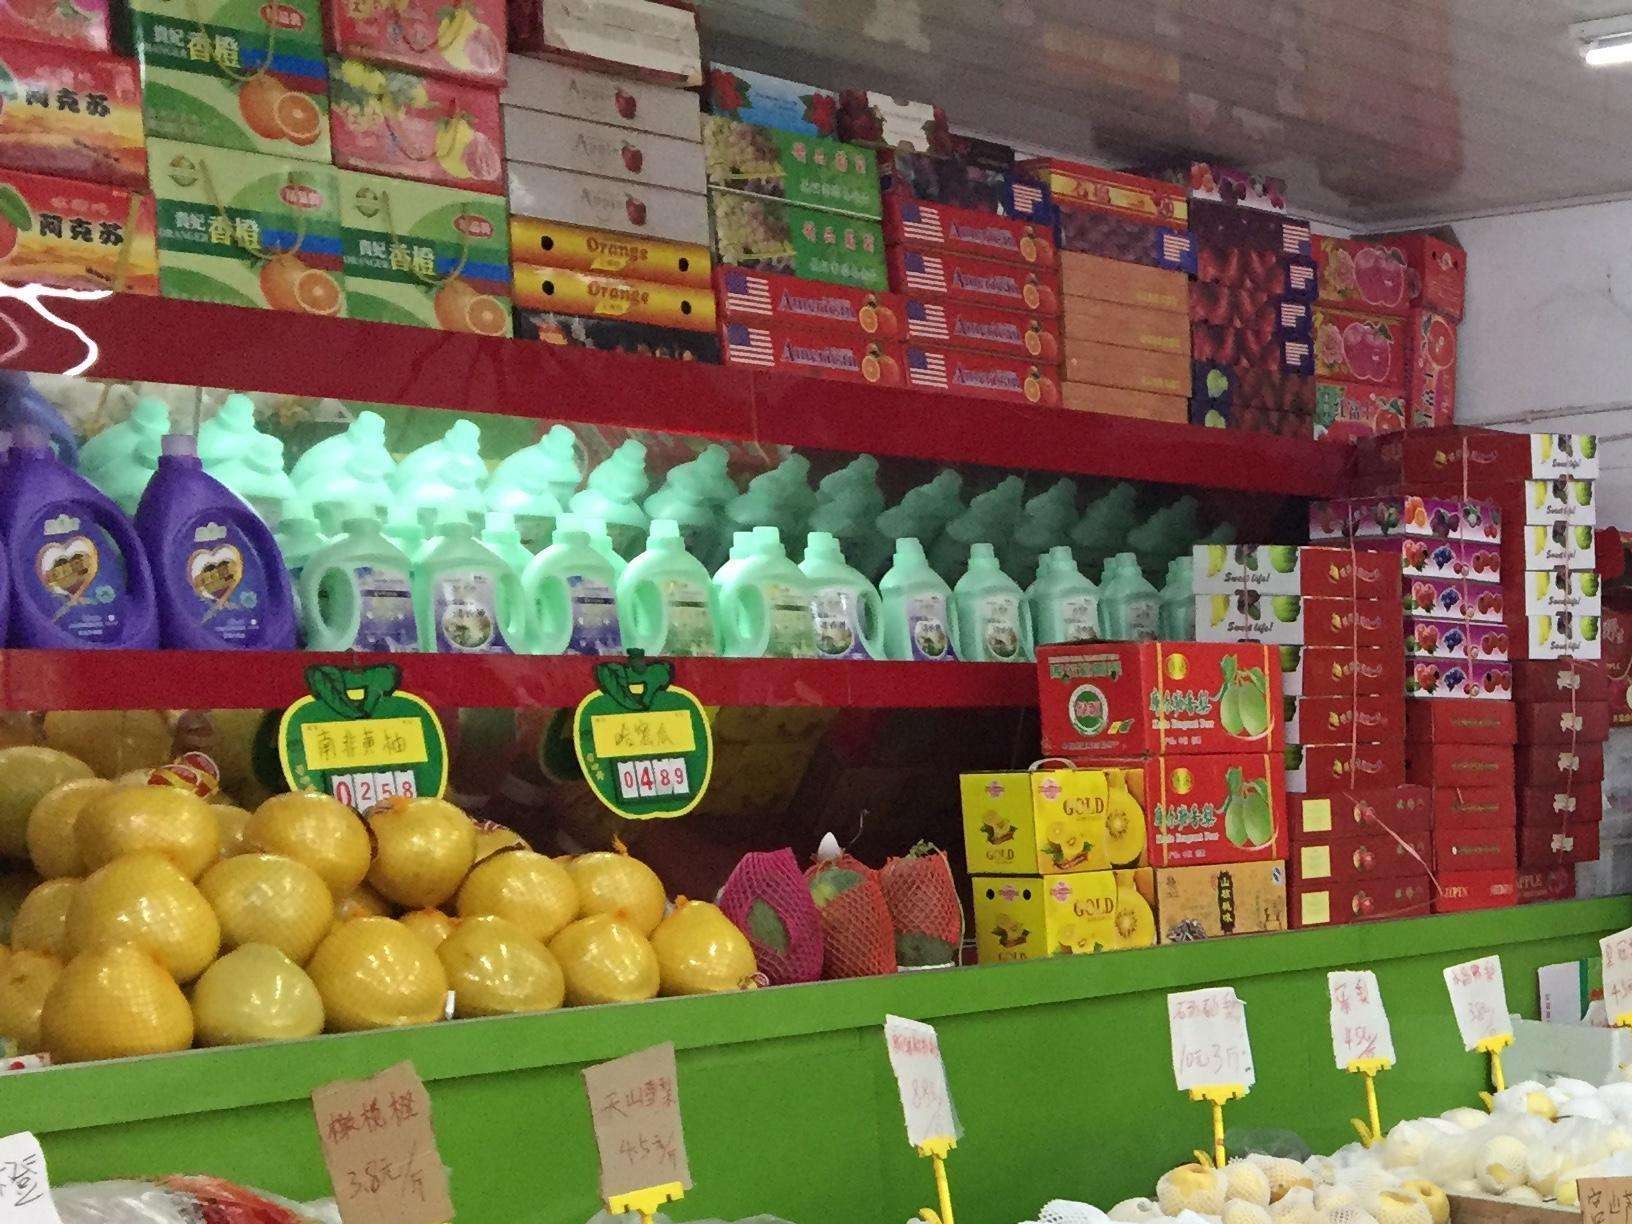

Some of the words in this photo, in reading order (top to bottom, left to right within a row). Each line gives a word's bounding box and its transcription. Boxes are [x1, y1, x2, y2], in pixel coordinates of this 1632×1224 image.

[623, 766, 685, 791] 0489
[336, 780, 414, 806] 0258
[1062, 797, 1105, 816] GOLD
[985, 848, 1015, 861] GOLD
[1073, 897, 1115, 917] GOLD
[0, 1153, 44, 1207] 橙
